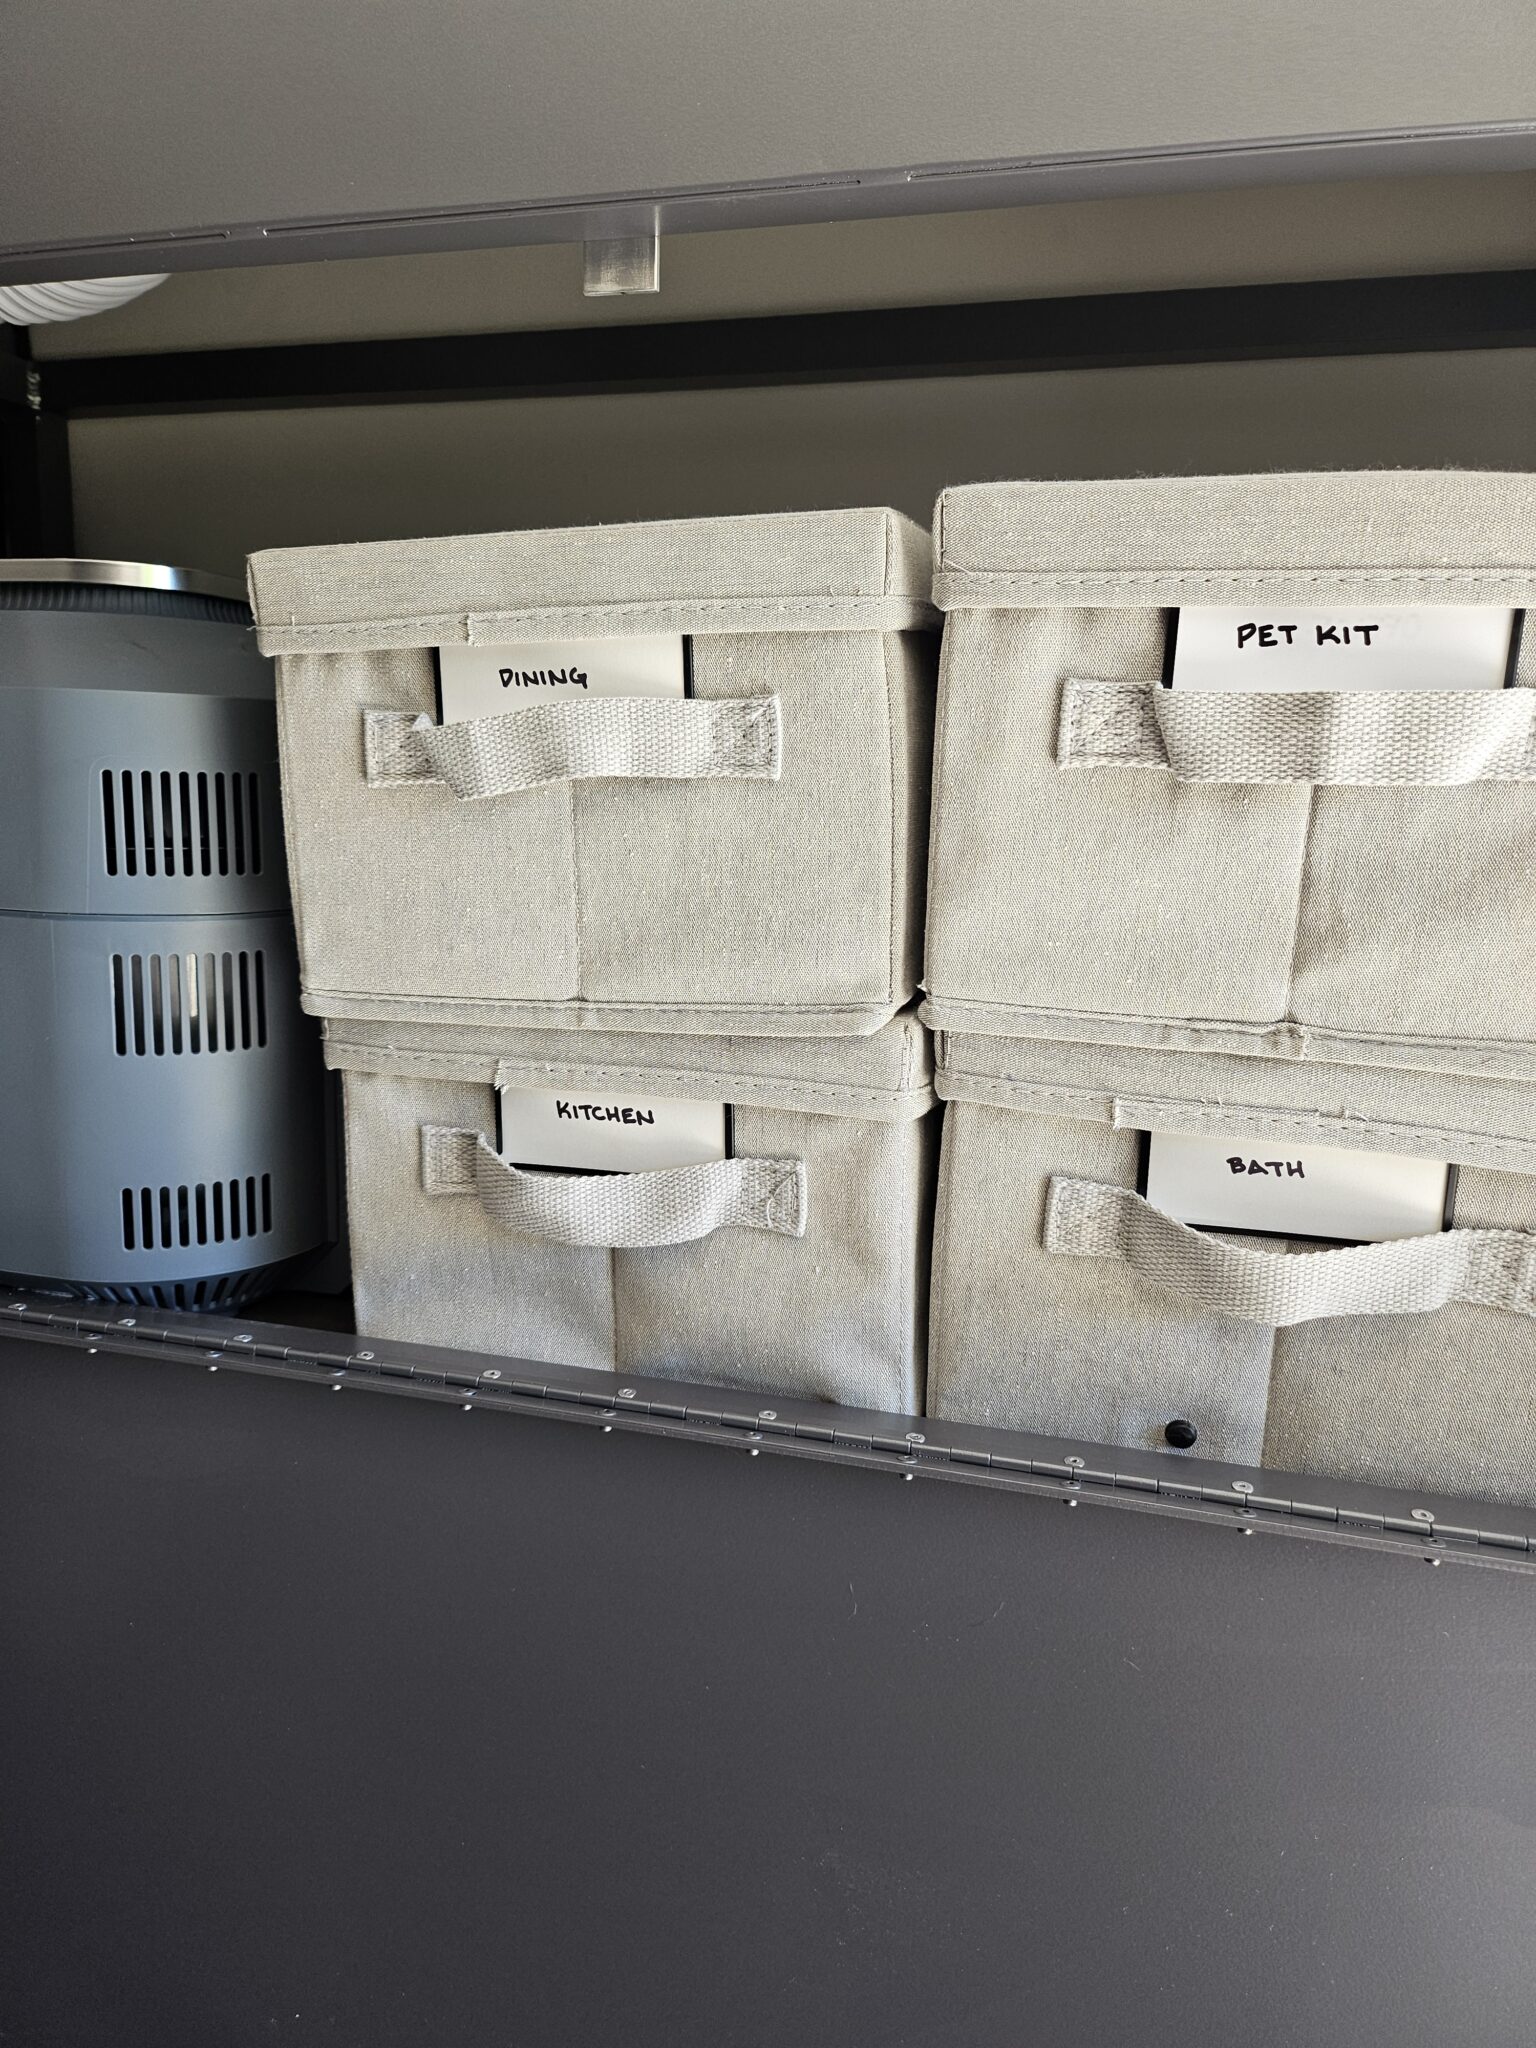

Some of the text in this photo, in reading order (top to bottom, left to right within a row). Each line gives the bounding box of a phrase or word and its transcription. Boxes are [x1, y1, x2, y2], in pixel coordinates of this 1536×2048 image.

[1236, 622, 1298, 649] PET
[1315, 625, 1380, 646] KIT
[498, 666, 588, 690] DINING
[556, 1099, 655, 1126] KITCHEN
[1226, 1156, 1305, 1179] BATH
